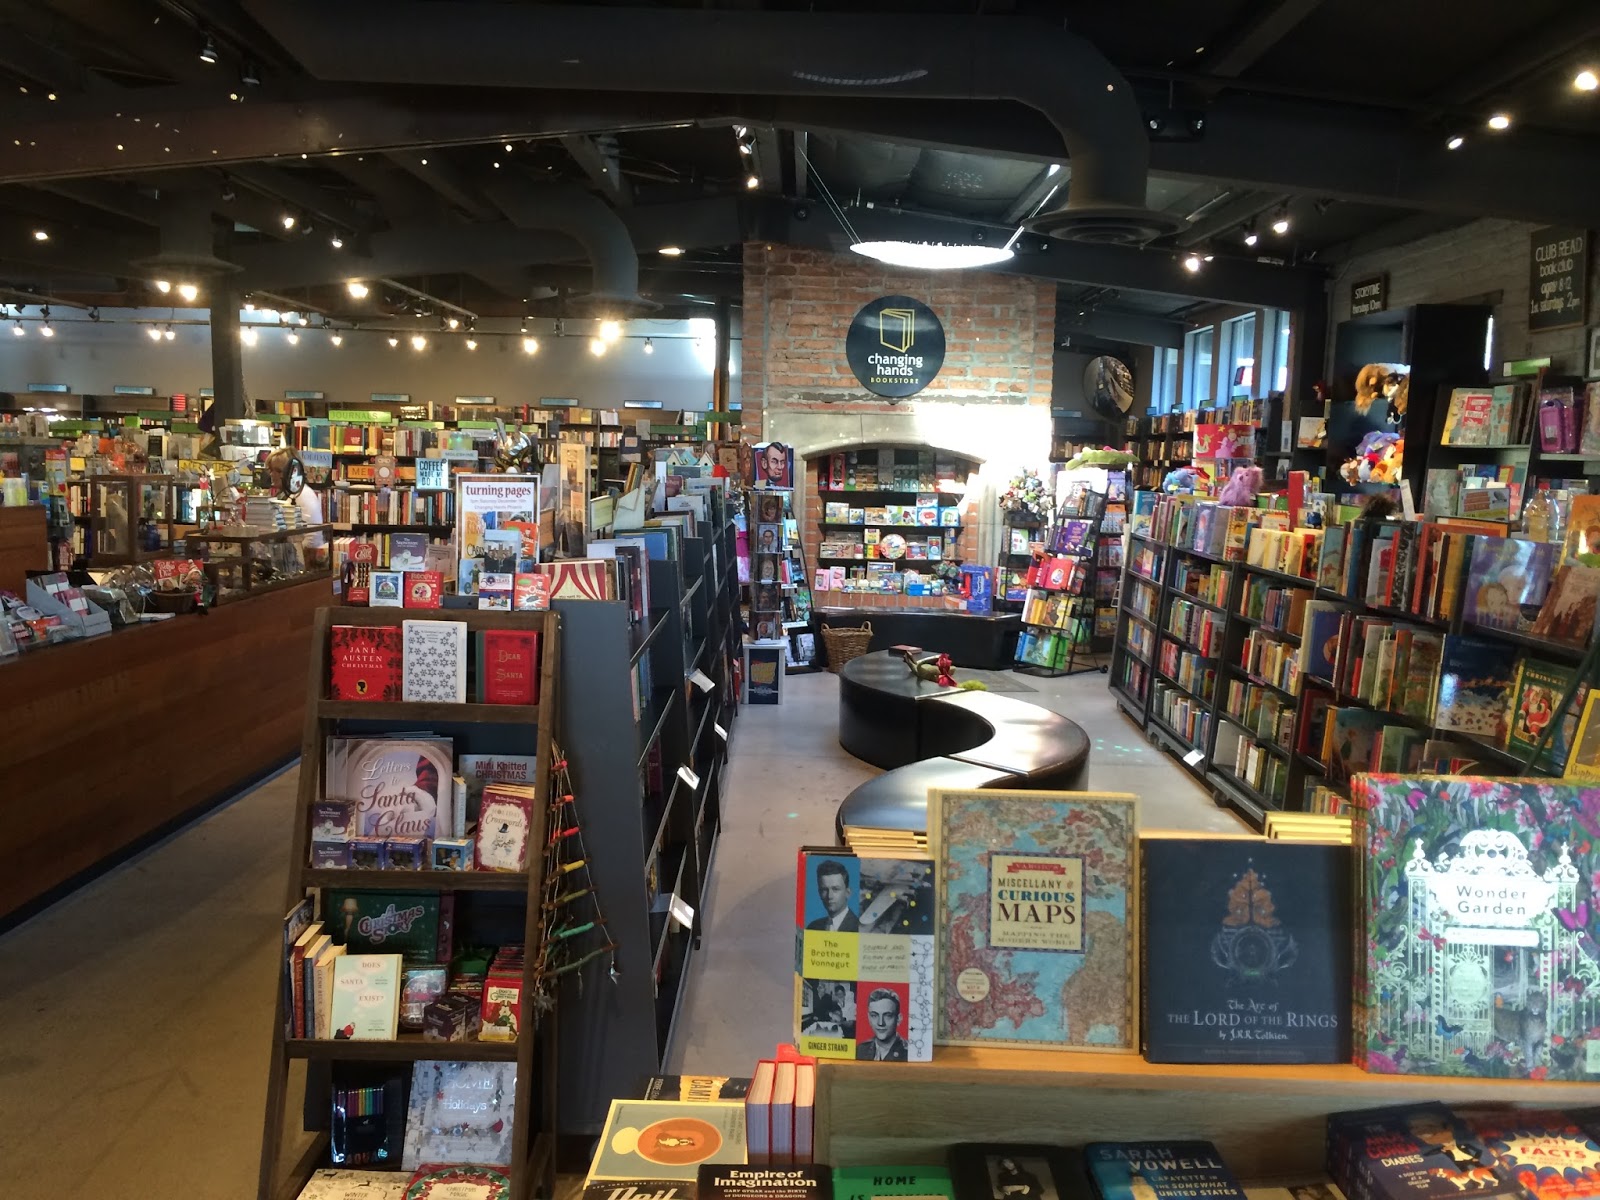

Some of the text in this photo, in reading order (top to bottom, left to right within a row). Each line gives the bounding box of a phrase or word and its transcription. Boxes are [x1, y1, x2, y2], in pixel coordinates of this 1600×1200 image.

[1535, 236, 1583, 262] CLUB READ
[867, 353, 924, 368] changing
[876, 364, 914, 376] hands
[331, 411, 379, 420] JOURNALS
[419, 460, 444, 471] COFFEE
[421, 478, 431, 486] DO
[466, 484, 532, 498] turning pages
[349, 646, 376, 654] JANE
[361, 757, 411, 781] Letters
[475, 760, 528, 770] Mini Knitted
[475, 770, 527, 780] CHRISTMAS
[356, 781, 422, 813] Santa
[367, 810, 431, 838] Claus
[998, 878, 1062, 889] MISCELLANY
[997, 889, 1075, 903] CURIOUS
[1456, 885, 1527, 899] Wonder
[1457, 900, 1526, 915] Garden
[997, 902, 1076, 925] MAPS
[823, 940, 839, 948] The
[810, 949, 851, 959] Brothers
[810, 959, 851, 970] Vonnegut
[1226, 1000, 1245, 1010] The
[1167, 1010, 1339, 1028] THE LORD OF THE RINGS
[1218, 1030, 1227, 1040] by
[808, 1041, 848, 1052] GINGER STRAND
[1100, 1148, 1174, 1161] SARAH
[1520, 1146, 1587, 1159] FACTS
[1128, 1158, 1223, 1171] VOWELL
[1381, 1154, 1425, 1168] DIARIES
[730, 1170, 804, 1180] Empire of
[714, 1177, 817, 1188] Imagination
[873, 1176, 916, 1186] HOME
[1172, 1181, 1228, 1189] SOMEWHAT
